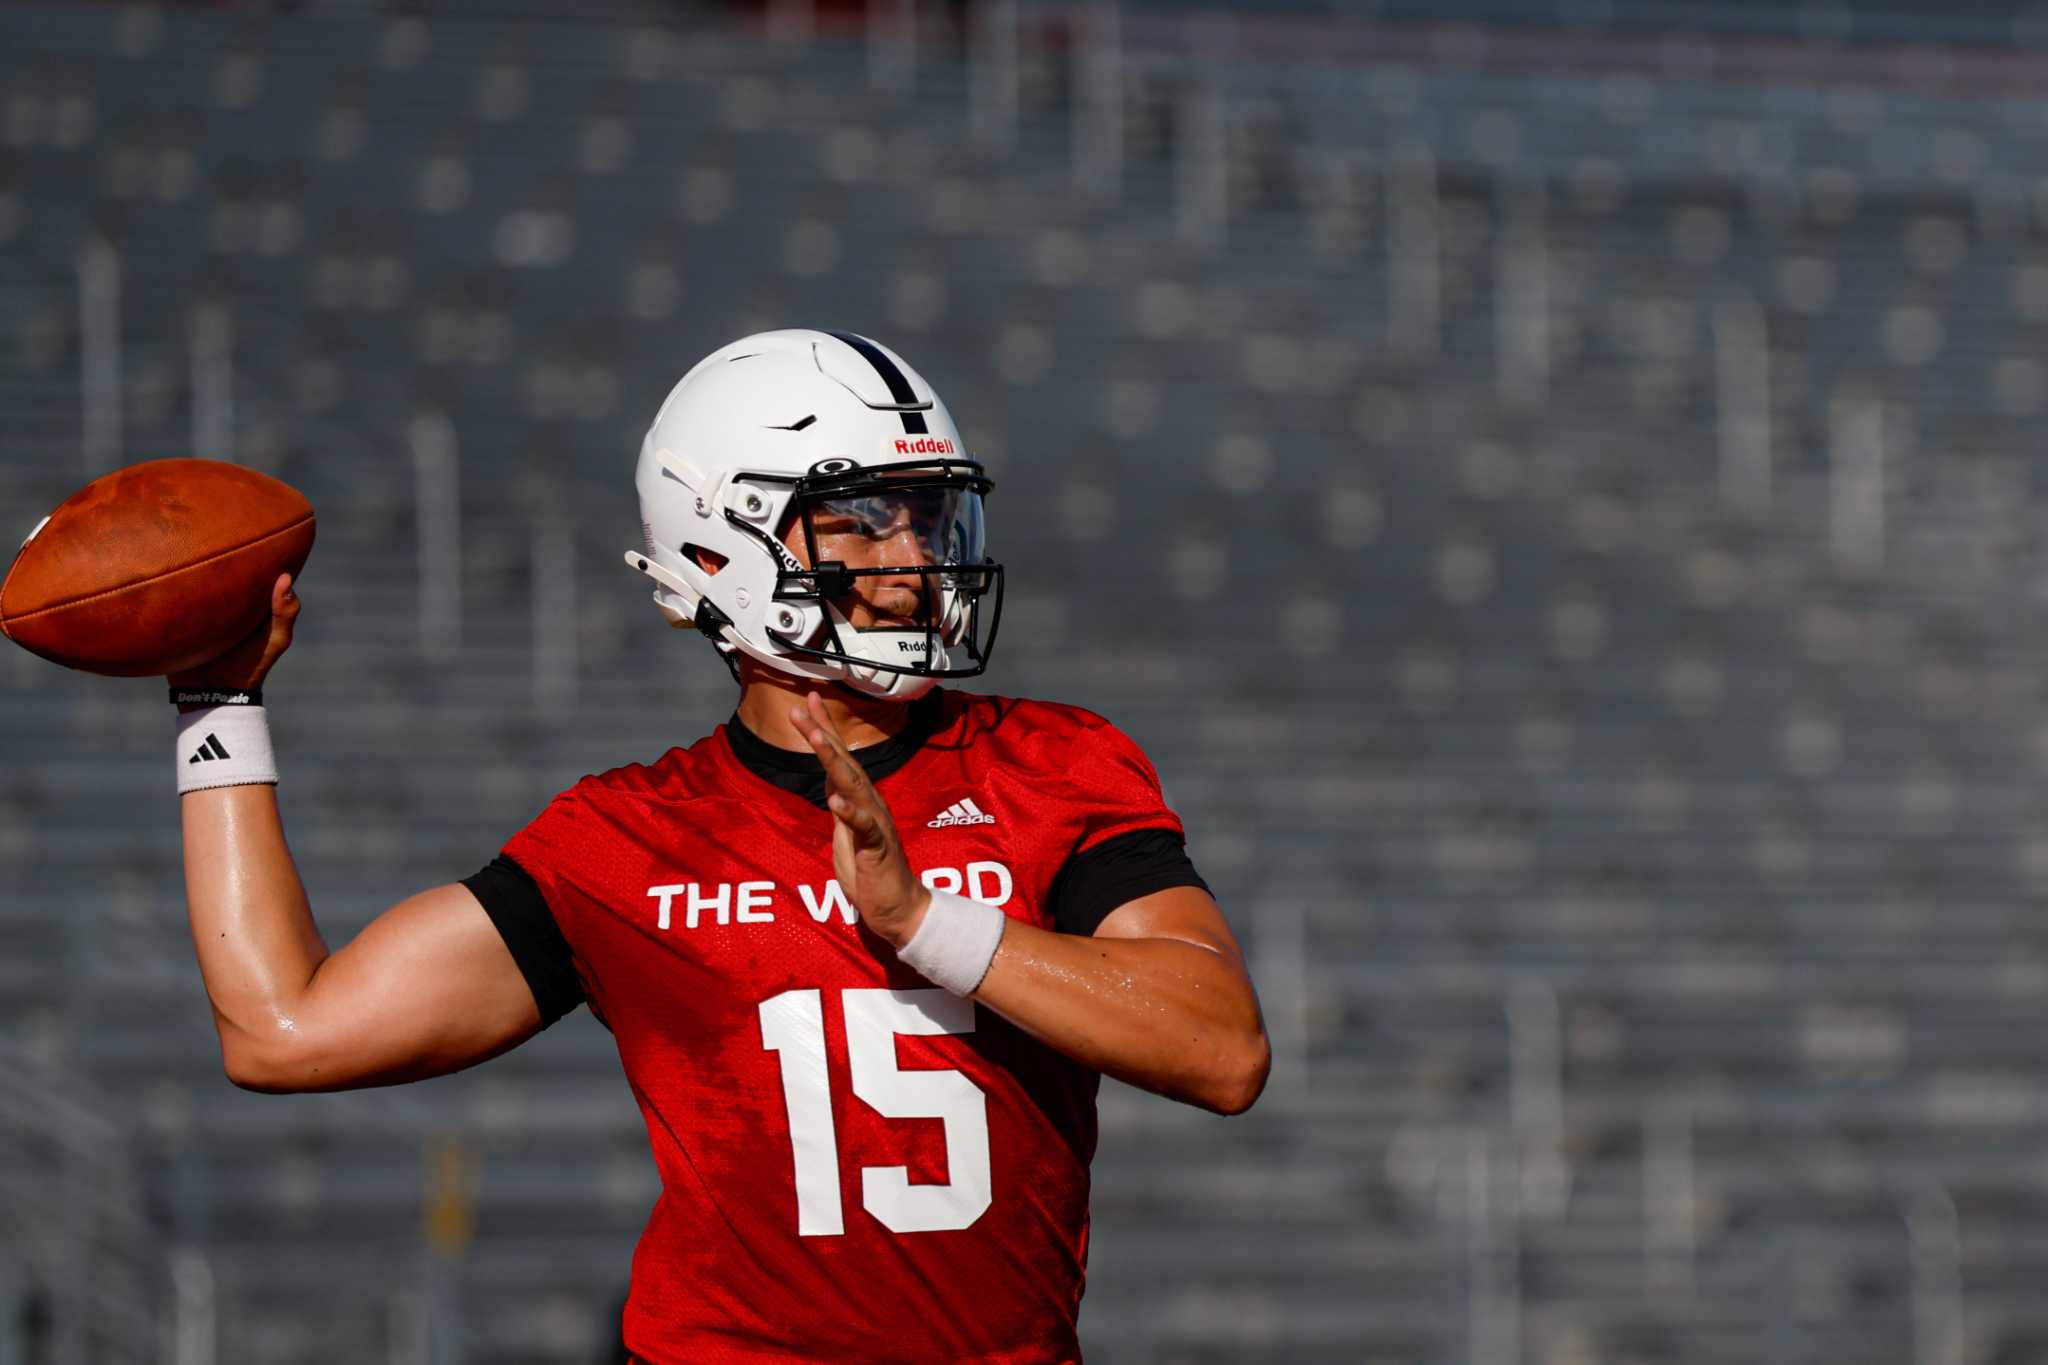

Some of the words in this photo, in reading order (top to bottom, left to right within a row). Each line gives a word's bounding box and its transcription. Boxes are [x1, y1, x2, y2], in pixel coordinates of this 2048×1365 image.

[895, 438, 954, 454] Riddell
[897, 641, 928, 652] Ridd
[927, 814, 996, 829] adidas
[646, 880, 776, 931] THE
[797, 860, 1013, 925] WRD
[757, 988, 993, 1237] 15
